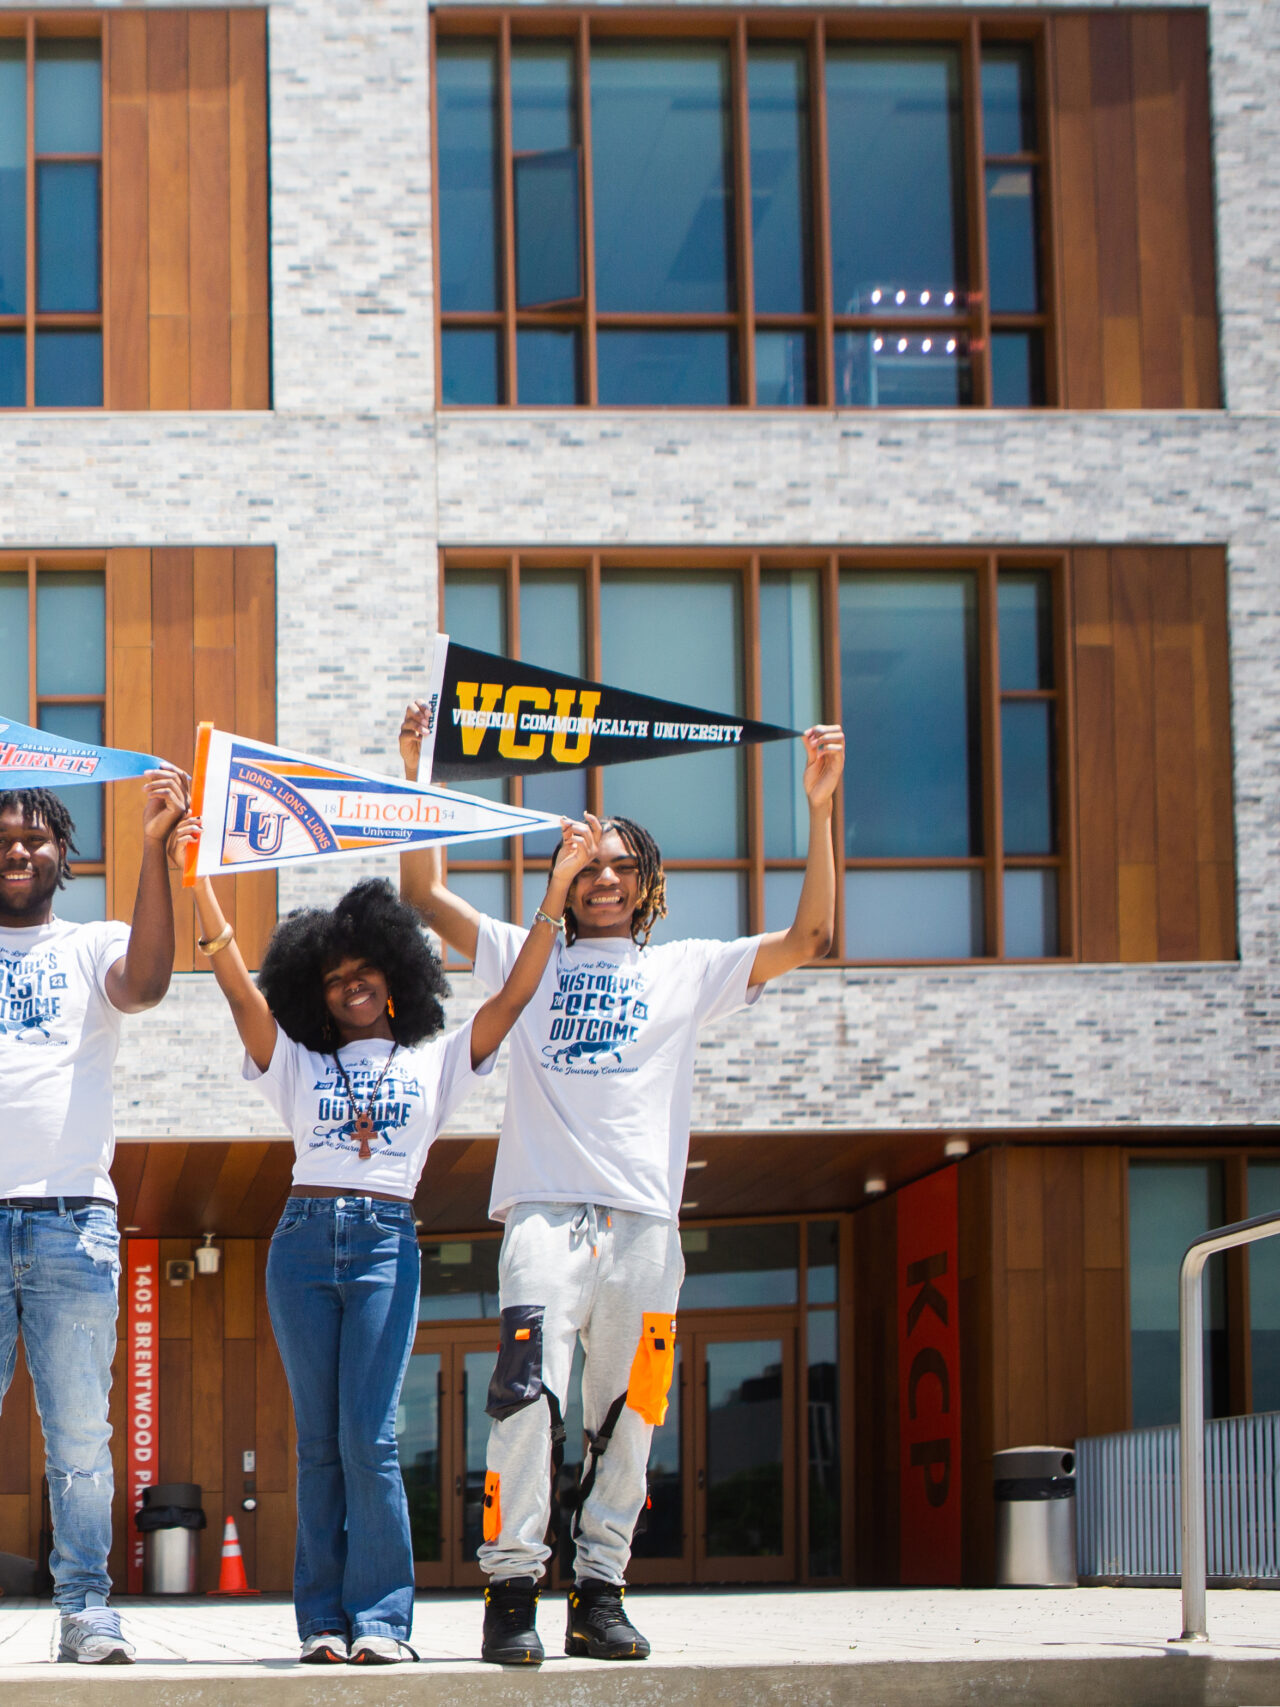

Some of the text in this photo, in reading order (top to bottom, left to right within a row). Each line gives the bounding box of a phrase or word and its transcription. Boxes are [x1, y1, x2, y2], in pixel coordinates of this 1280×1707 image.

[452, 708, 744, 743] VIRGINIA COMMONWEALTH UNIVERSITY
[455, 681, 601, 764] VCU
[22, 743, 68, 754] DELAWARE
[238, 768, 331, 849] LIONS LIONS LIONS
[323, 795, 455, 823] 18 Lincoln 54
[228, 793, 290, 855] LU
[362, 826, 413, 839] University
[565, 993, 632, 1022] BEST
[549, 1018, 639, 1042] OUTCOME
[551, 1064, 563, 1072] the
[565, 1066, 599, 1076] Journey
[601, 1065, 638, 1074] Continues
[319, 1098, 412, 1126] OUTOME
[335, 1143, 361, 1153] Journ
[134, 1265, 152, 1314] 1405
[134, 1321, 152, 1462] BRENTWOOD
[906, 1251, 952, 1508] KCP
